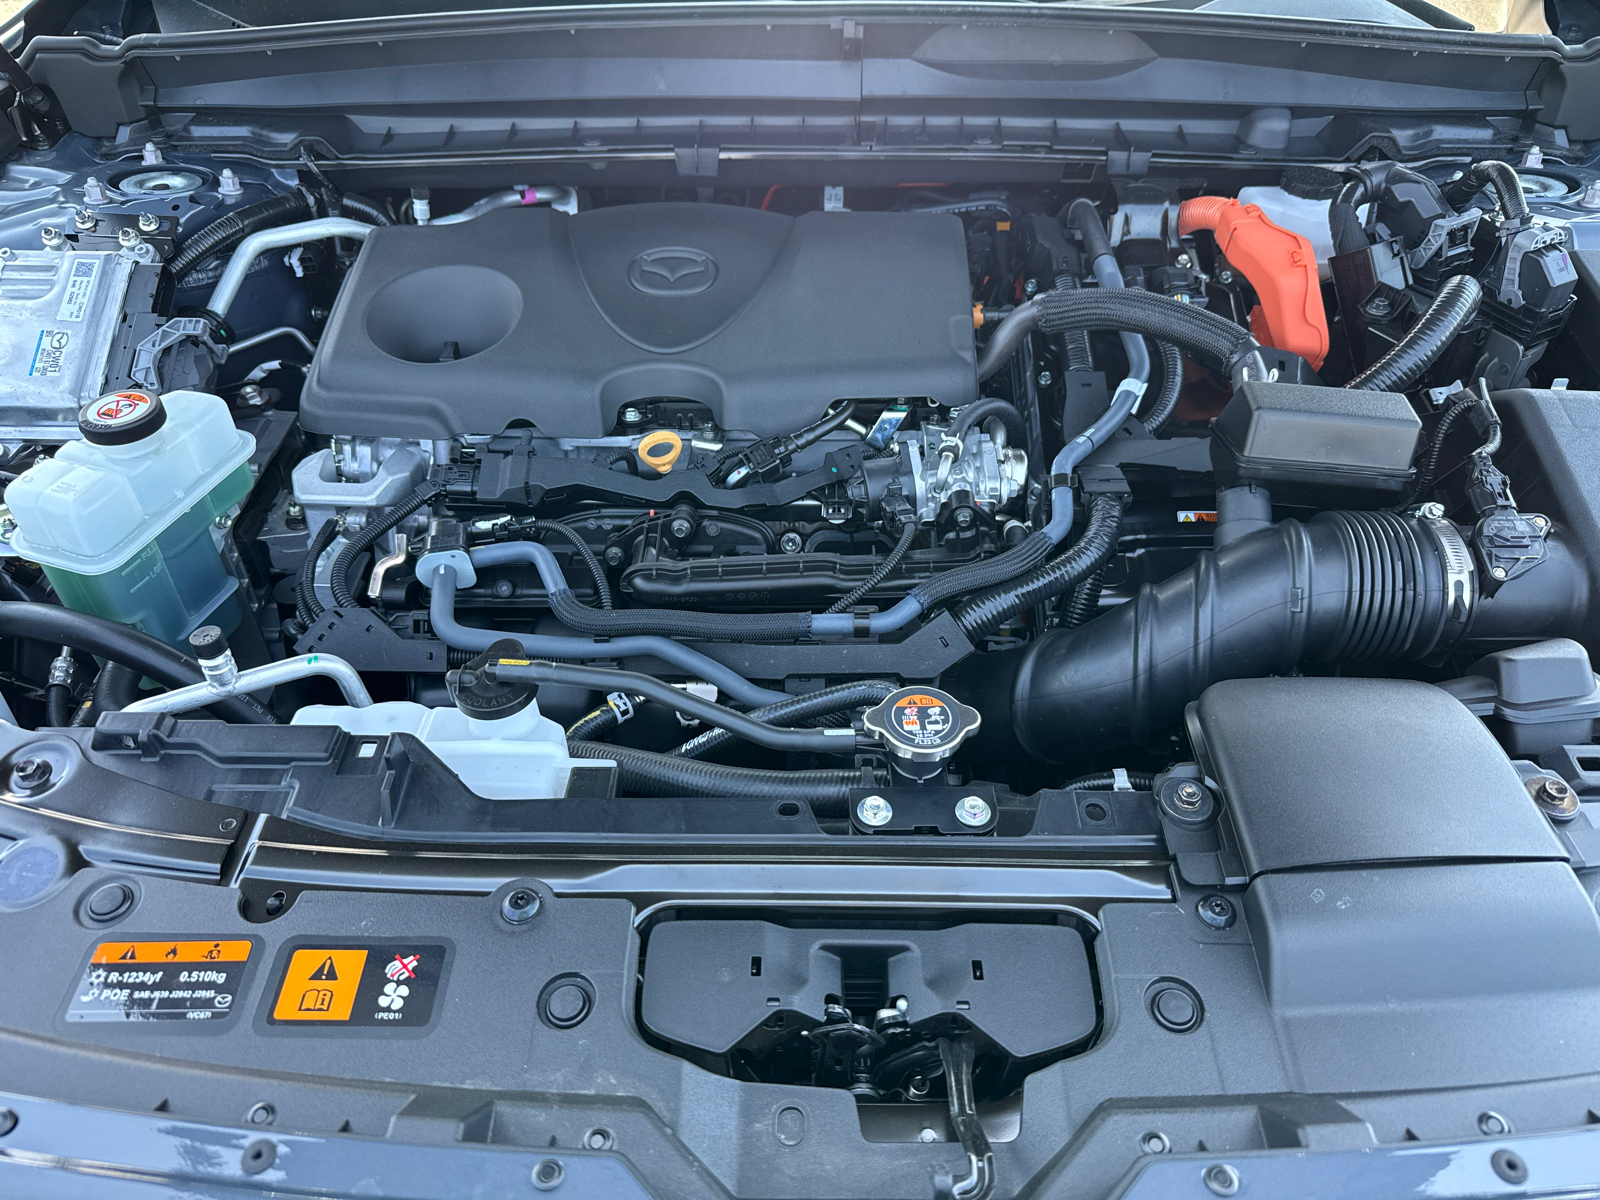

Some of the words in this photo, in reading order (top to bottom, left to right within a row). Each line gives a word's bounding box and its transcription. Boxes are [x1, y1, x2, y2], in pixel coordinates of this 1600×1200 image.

[48, 350, 63, 373] CW01
[461, 692, 515, 707] COOLANT
[914, 737, 931, 745] FL22
[106, 971, 163, 985] R-1234yf
[179, 970, 227, 984] 0.510kg
[100, 989, 131, 1001] POE
[132, 990, 151, 999] SAE
[186, 1011, 212, 1020] (VC67)
[374, 1012, 402, 1020] (PE01)
